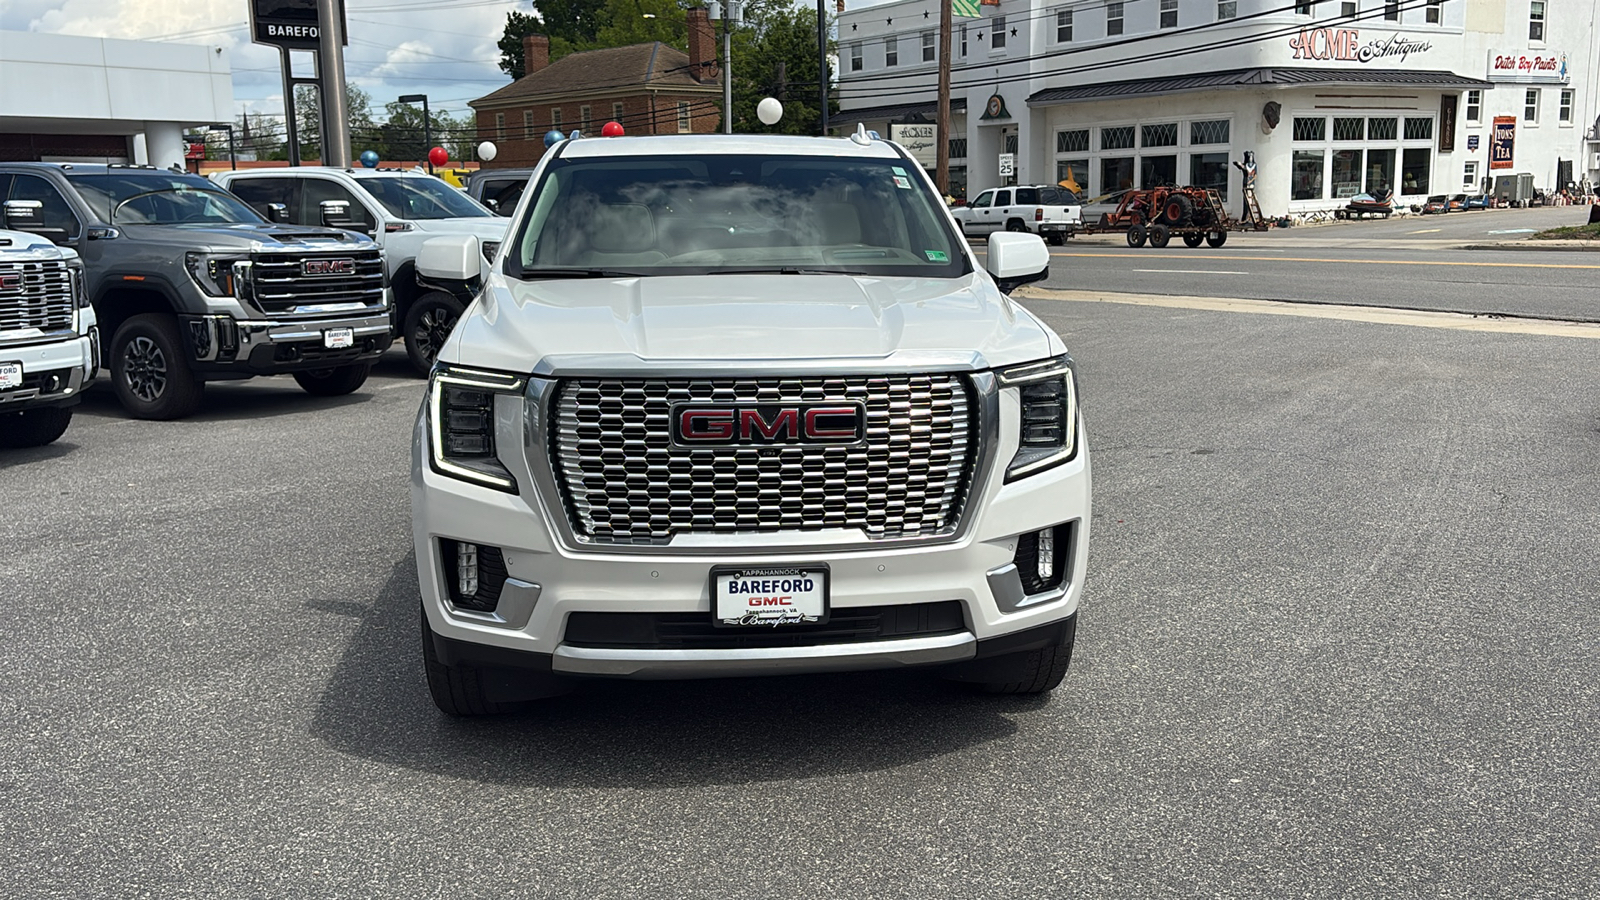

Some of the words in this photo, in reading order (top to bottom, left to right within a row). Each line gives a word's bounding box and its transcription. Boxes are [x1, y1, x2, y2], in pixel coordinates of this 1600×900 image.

[267, 25, 321, 38] BAREFO
[1289, 27, 1359, 61] ACME
[1375, 31, 1433, 63] Antiques
[1494, 55, 1516, 70] Dutch
[1518, 56, 1533, 73] Boy
[1533, 56, 1558, 71] Paints
[1496, 146, 1511, 159] TEA
[1000, 165, 1012, 173] 25
[307, 261, 354, 273] GMC
[0, 367, 18, 375] FORD
[679, 407, 857, 440] GMC
[728, 579, 814, 594] BAREFORD
[748, 596, 792, 606] GMC
[739, 613, 804, 628] Bareford
